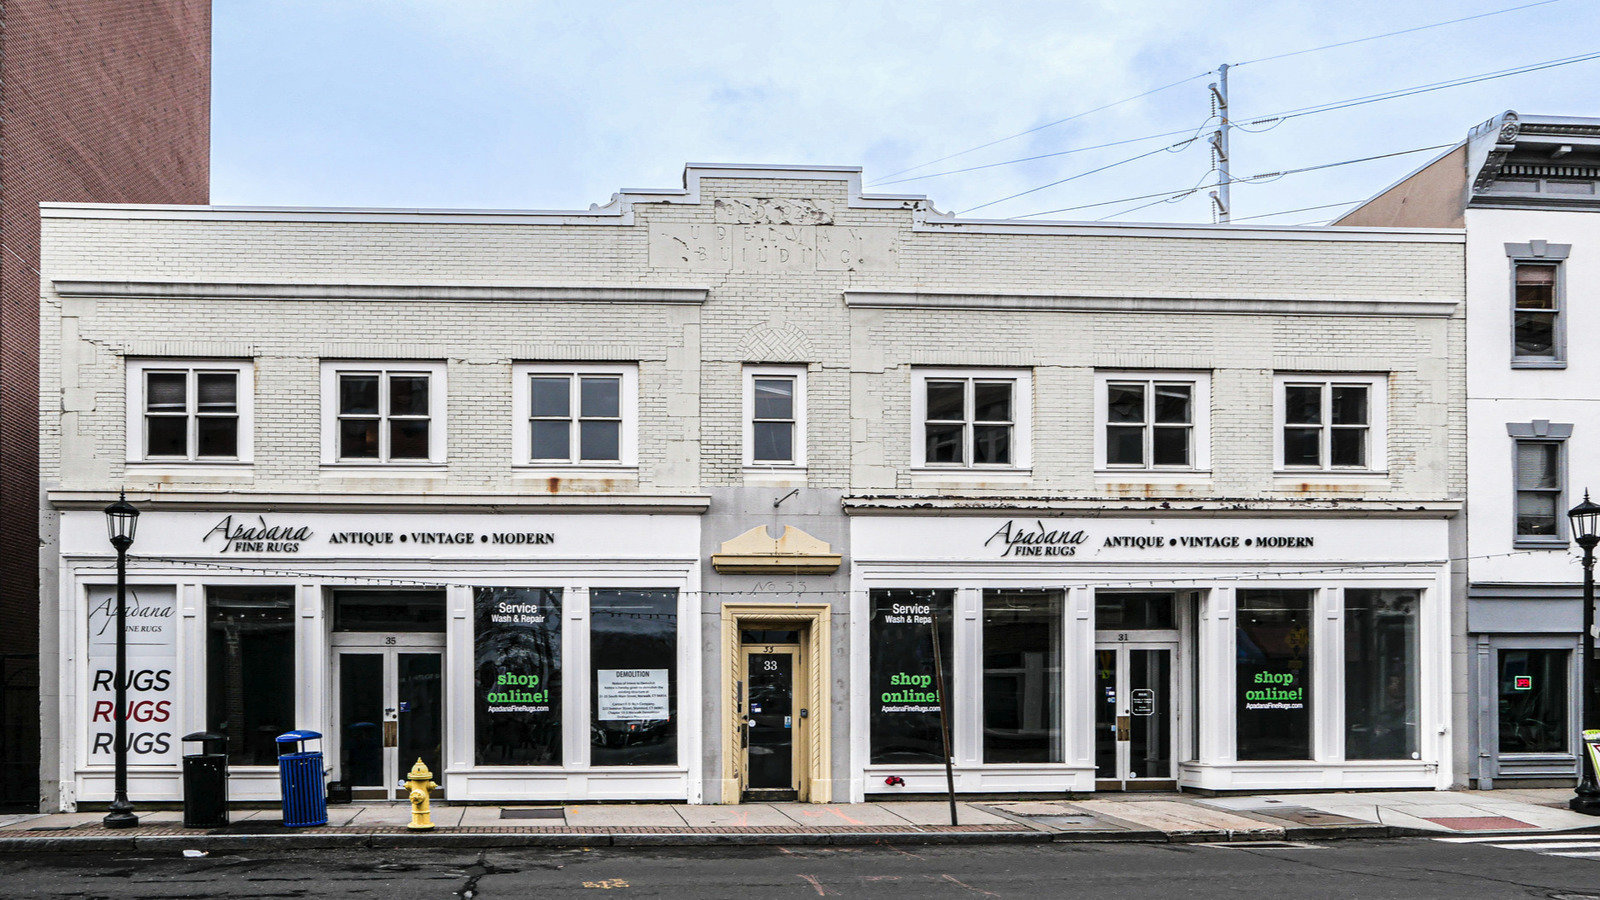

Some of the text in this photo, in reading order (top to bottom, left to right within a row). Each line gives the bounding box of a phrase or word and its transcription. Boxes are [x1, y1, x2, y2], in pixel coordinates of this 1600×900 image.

[698, 246, 851, 263] BUILDING
[202, 515, 314, 553] Apadana
[329, 532, 555, 546] ANTIQUE VINTAGE MODERN
[984, 520, 1090, 557] Apadana
[234, 542, 299, 552] FINE RUGS
[1103, 536, 1314, 549] ANTIQUE VINTAGE MODERN
[1015, 546, 1076, 556] FINE RUGS
[499, 602, 538, 613] Service
[892, 603, 930, 614] Service
[491, 614, 545, 624] Wash & Repair
[885, 615, 932, 625] Wash & Repa
[121, 625, 162, 633] INE RUGS
[385, 637, 396, 645] 35
[763, 660, 778, 671] 33
[497, 672, 539, 688] shop
[890, 672, 931, 688] shop
[1254, 671, 1294, 686] shop
[487, 689, 549, 703] online!
[881, 689, 940, 703] online!
[1246, 687, 1303, 700] online!
[488, 705, 549, 713] ApadanaFineRugs.com
[1246, 702, 1303, 710] ApadanaFineRugs.com
